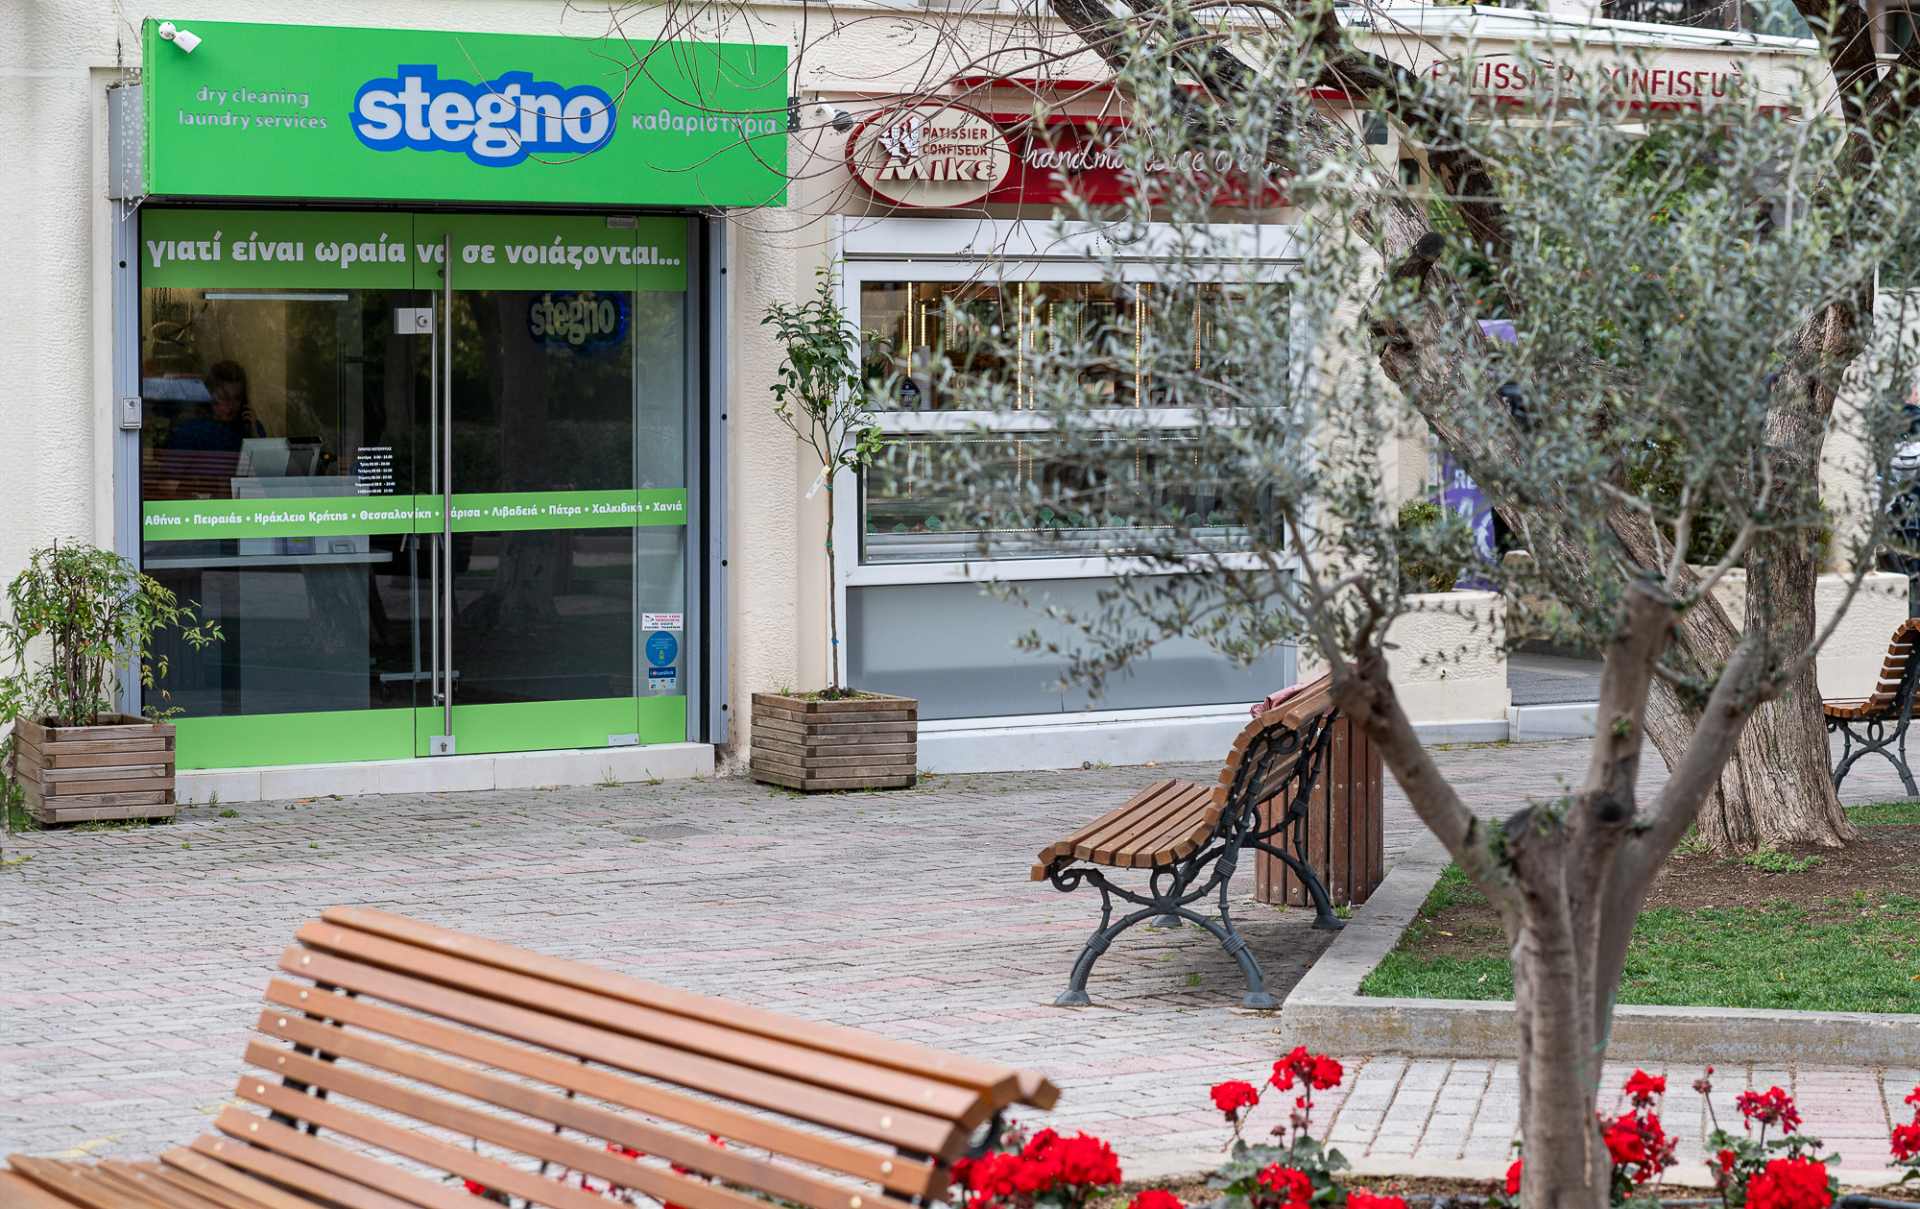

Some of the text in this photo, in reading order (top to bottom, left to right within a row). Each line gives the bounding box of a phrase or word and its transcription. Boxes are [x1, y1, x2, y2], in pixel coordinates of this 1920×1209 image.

[196, 86, 310, 109] dry cleaning
[178, 108, 328, 130] laundry services
[358, 76, 609, 157] stegno
[922, 127, 988, 139] PATISSIER
[922, 143, 988, 156] CONFISEUR
[147, 230, 223, 268] γιατί
[232, 231, 304, 262] είναι
[315, 232, 406, 269] ωραία
[462, 244, 496, 264] σε
[505, 235, 680, 271] νοιάζονται...
[530, 292, 615, 345] stegno
[144, 513, 181, 526] Αθήνα
[193, 511, 242, 527] Πειραιάς
[254, 511, 305, 526] Ηράκλειο
[443, 506, 481, 520] άρισα
[491, 506, 538, 518] Λιβαδειά
[548, 504, 582, 517] Πάτρα
[652, 500, 683, 512] Χανιά
